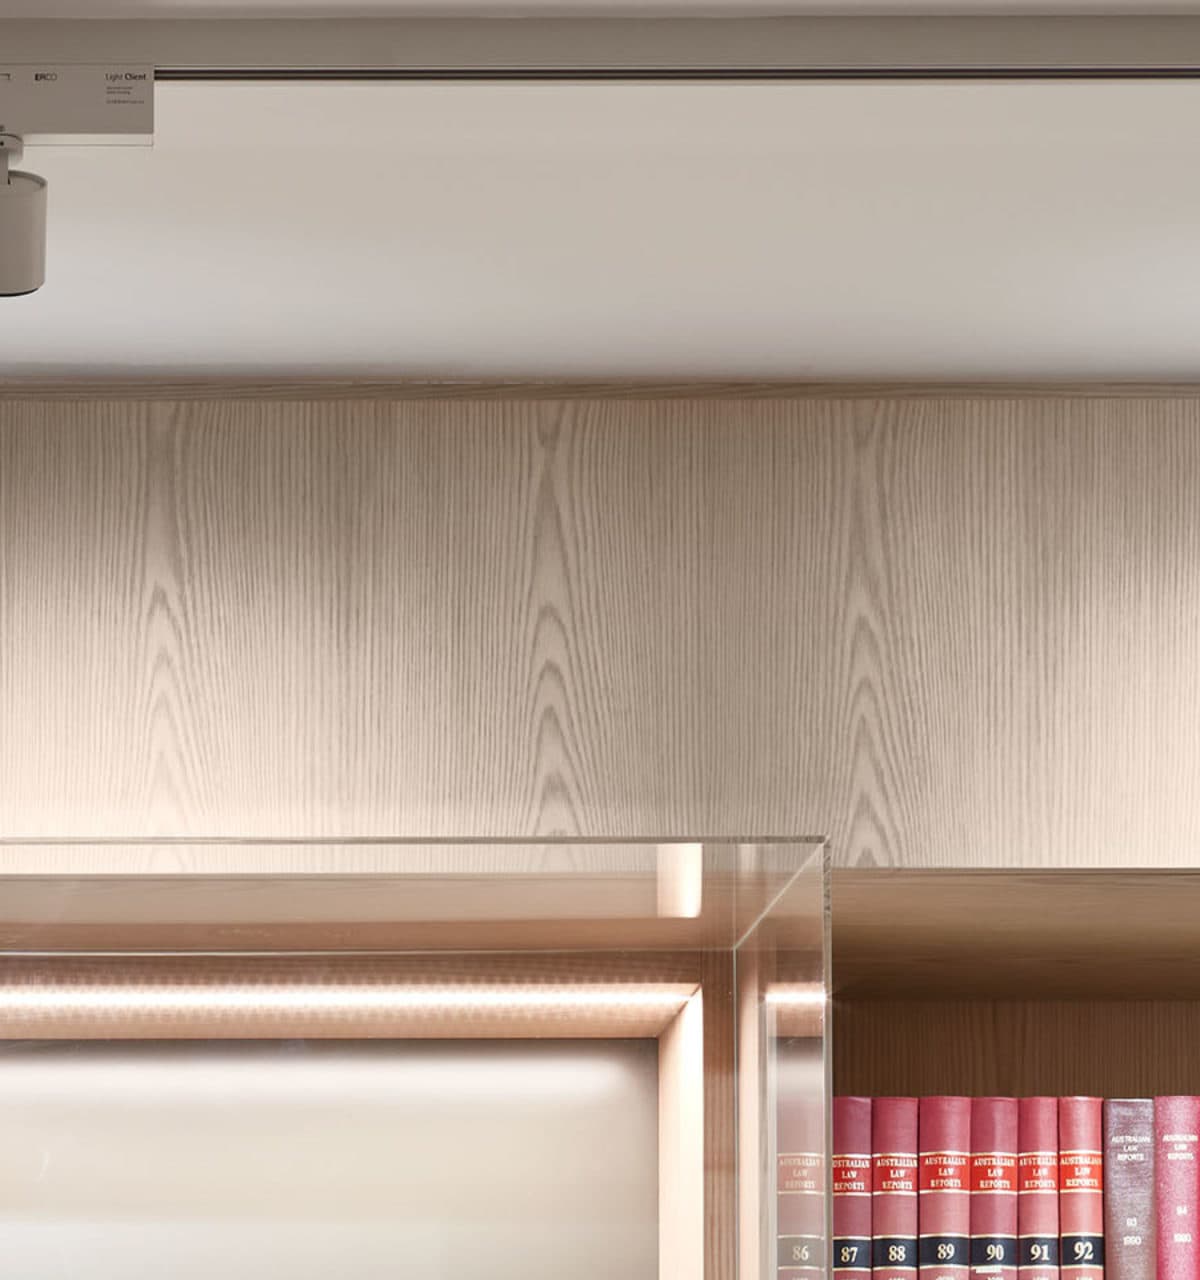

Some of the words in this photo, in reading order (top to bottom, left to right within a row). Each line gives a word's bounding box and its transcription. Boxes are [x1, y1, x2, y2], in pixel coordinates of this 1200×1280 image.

[840, 1245, 860, 1264] 87
[887, 1244, 908, 1263] 88
[936, 1241, 957, 1261] 89
[985, 1242, 1006, 1262] 90
[1029, 1243, 1052, 1262] 91
[1073, 1240, 1095, 1261] 92
